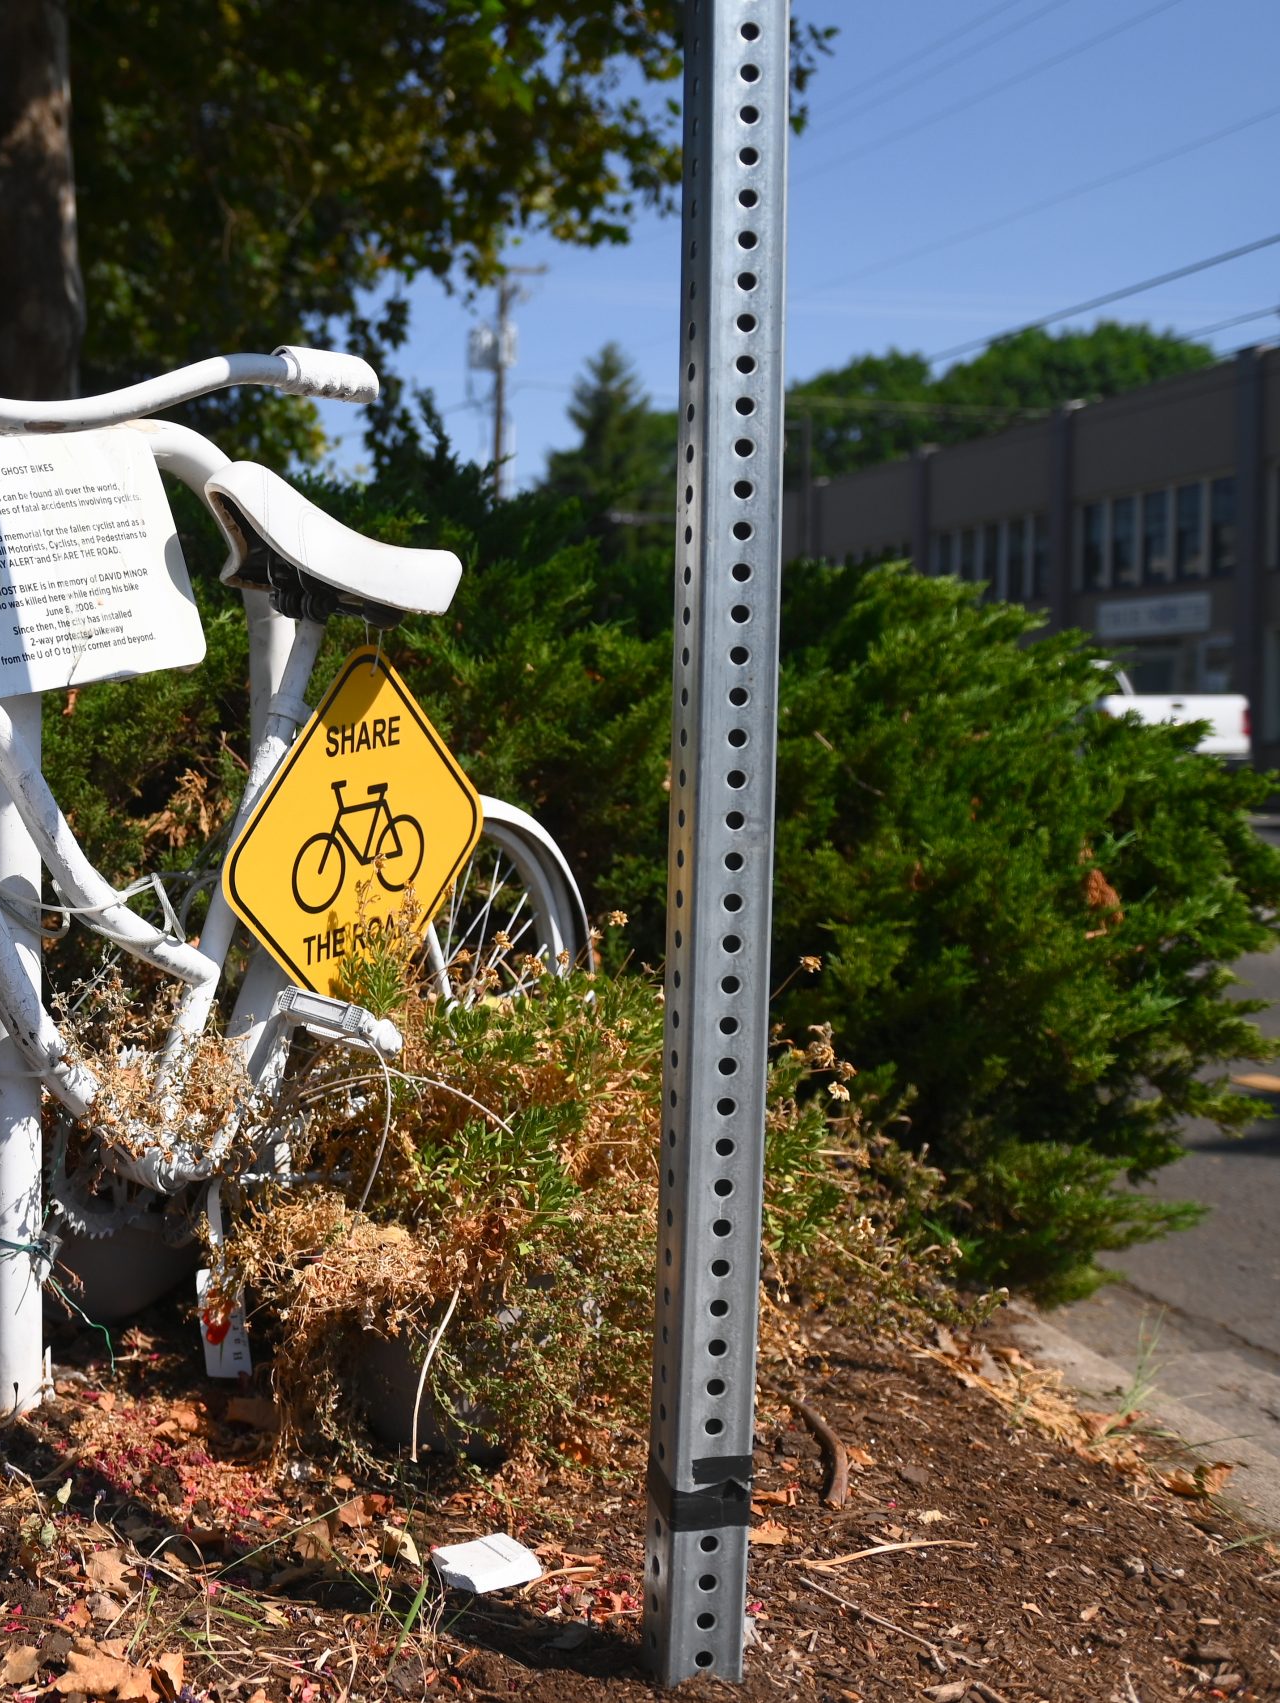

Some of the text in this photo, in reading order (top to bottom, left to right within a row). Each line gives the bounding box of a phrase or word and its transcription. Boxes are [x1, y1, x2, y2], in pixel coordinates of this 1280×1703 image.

[1, 464, 54, 476] GHOST BIKES
[3, 494, 17, 502] can
[18, 492, 29, 500] be
[30, 489, 52, 499] found
[54, 488, 64, 496] all
[64, 487, 82, 495] over
[82, 485, 96, 494] the
[96, 482, 120, 492] world,
[12, 505, 22, 514] of
[22, 502, 40, 512] fatal
[42, 500, 78, 511] accidents
[78, 496, 112, 506] involving
[4, 530, 42, 542] memorial
[42, 528, 54, 536] for
[56, 526, 68, 535] the
[70, 524, 91, 534] fallen
[92, 521, 115, 532] cyclist
[116, 518, 130, 528] and
[132, 518, 140, 526] as
[8, 543, 48, 554] Motorists,
[48, 538, 80, 550] Cyclists,
[82, 536, 95, 546] and
[96, 532, 138, 543] Pedestrians
[139, 530, 146, 538] to
[9, 556, 34, 568] ALERT
[38, 554, 51, 564] and
[80, 548, 96, 558] THE
[97, 546, 120, 556] ROAD.
[19, 582, 38, 593] BIKE
[40, 582, 46, 590] is
[48, 580, 56, 589] in
[56, 577, 88, 587] memory
[90, 574, 98, 584] of
[98, 572, 122, 582] DAVID
[122, 568, 148, 579] MINOR
[8, 600, 24, 608] was
[25, 595, 47, 606] killed
[48, 593, 66, 602] here
[68, 590, 88, 600] while
[89, 587, 112, 597] riding
[112, 585, 123, 594] his
[124, 582, 139, 592] bike
[12, 626, 34, 636] Since
[36, 622, 57, 632] then,
[58, 620, 70, 628] the
[86, 614, 100, 624] has
[102, 609, 132, 622] installed
[46, 608, 64, 616] June
[64, 605, 74, 614] 8,
[30, 636, 54, 646] 2-way
[94, 625, 124, 636] bikeway
[0, 632, 156, 666] from the U of O to this corner and beyond.
[325, 716, 401, 758] SHARE
[303, 913, 406, 966] THE ROA
